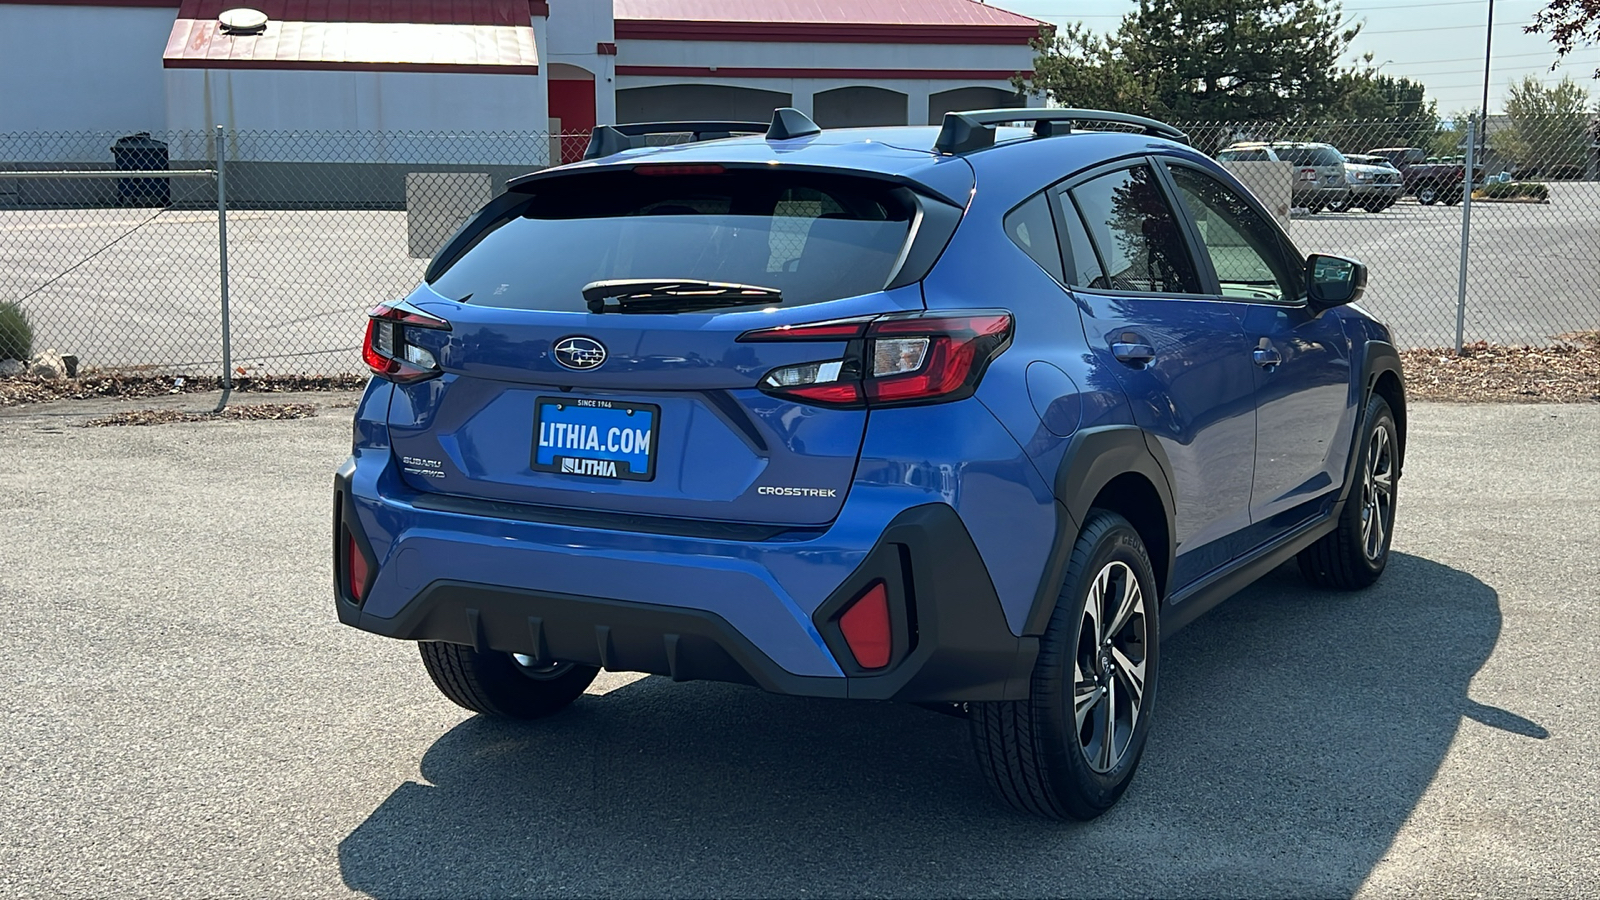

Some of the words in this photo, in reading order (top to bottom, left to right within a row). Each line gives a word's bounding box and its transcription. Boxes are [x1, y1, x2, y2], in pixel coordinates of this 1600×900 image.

[577, 399, 596, 407] SINCE
[539, 422, 651, 455] LITHIA.COM
[403, 456, 442, 468] SUBARU
[574, 458, 617, 477] LITHIA
[757, 486, 837, 498] CROSSTREK
